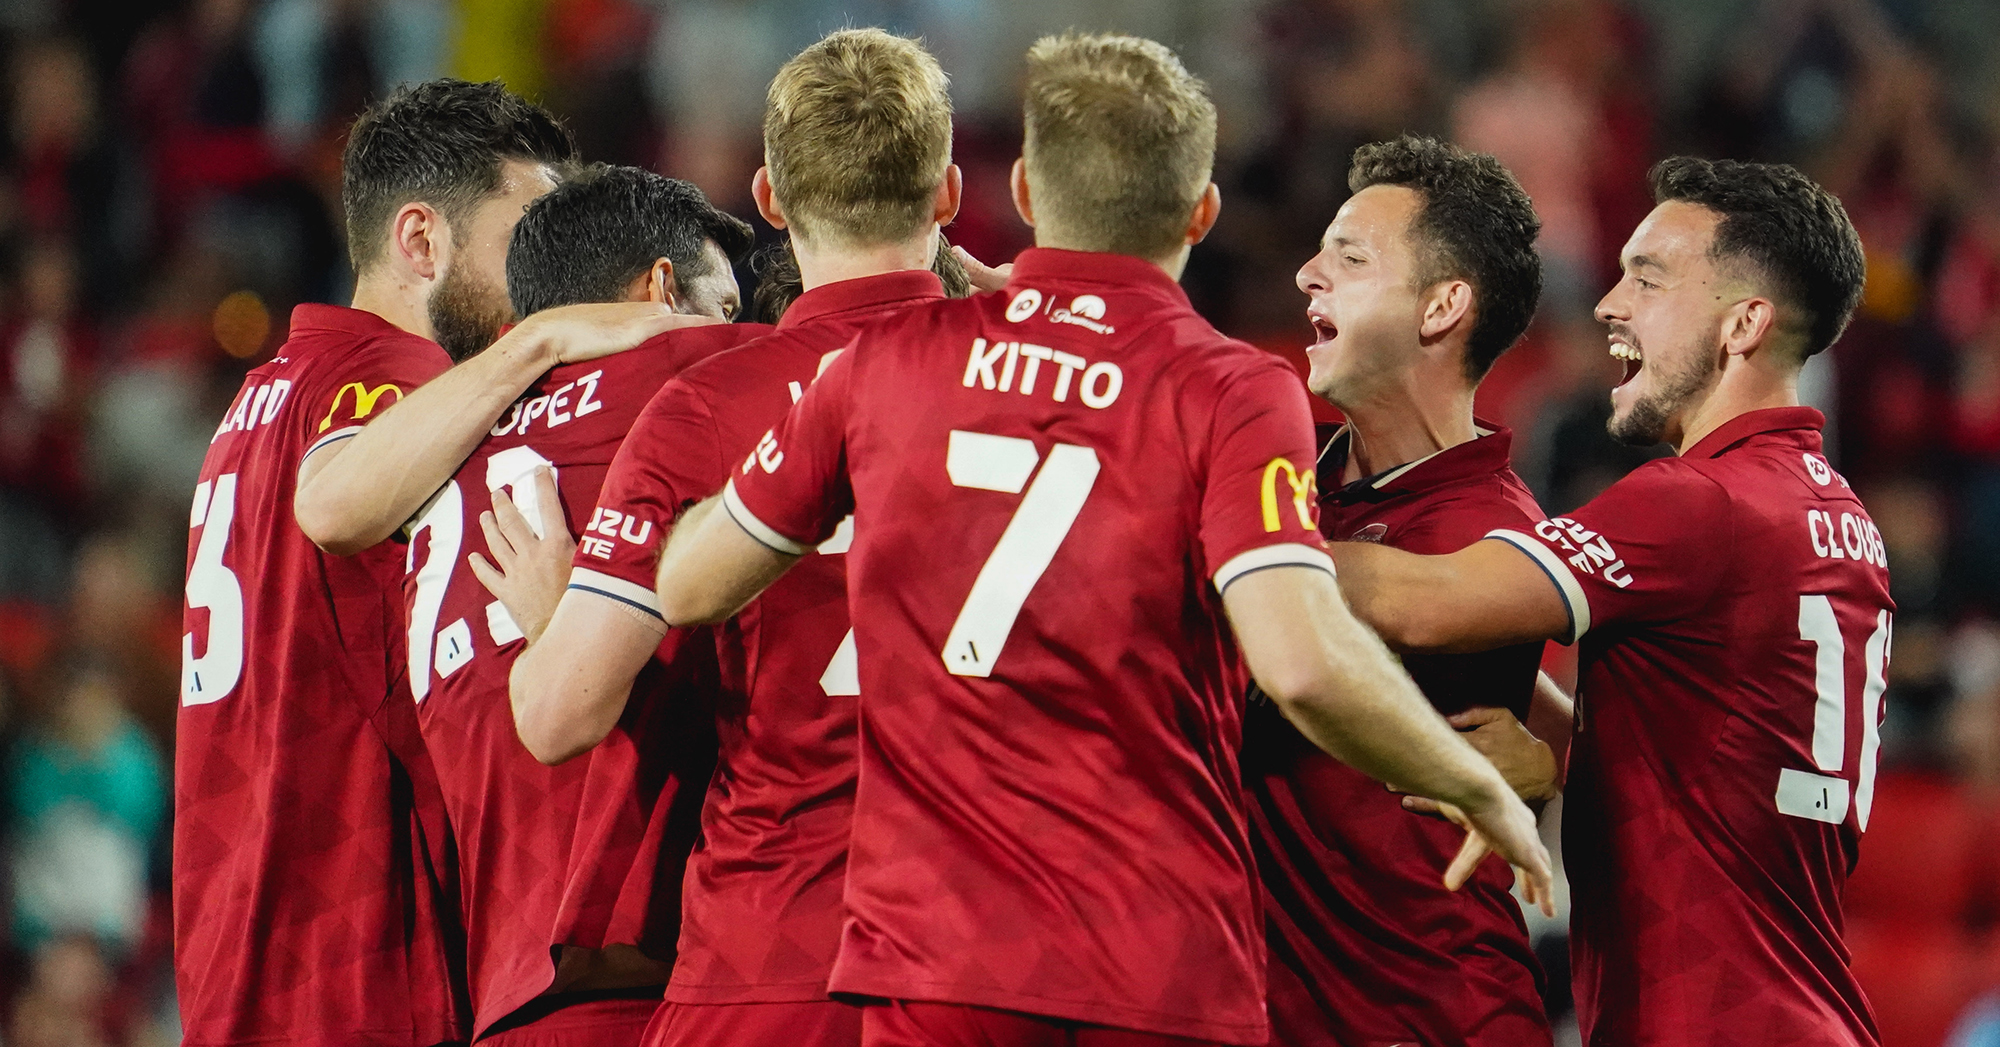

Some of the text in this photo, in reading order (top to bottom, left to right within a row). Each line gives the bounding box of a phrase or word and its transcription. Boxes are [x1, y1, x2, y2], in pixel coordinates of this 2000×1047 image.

[490, 370, 602, 436] OPEZ
[962, 338, 1123, 409] KITTO
[581, 535, 615, 560] TE
[586, 507, 652, 545] UZU
[941, 430, 1101, 677] 7
[1808, 509, 1888, 569] CLOUG
